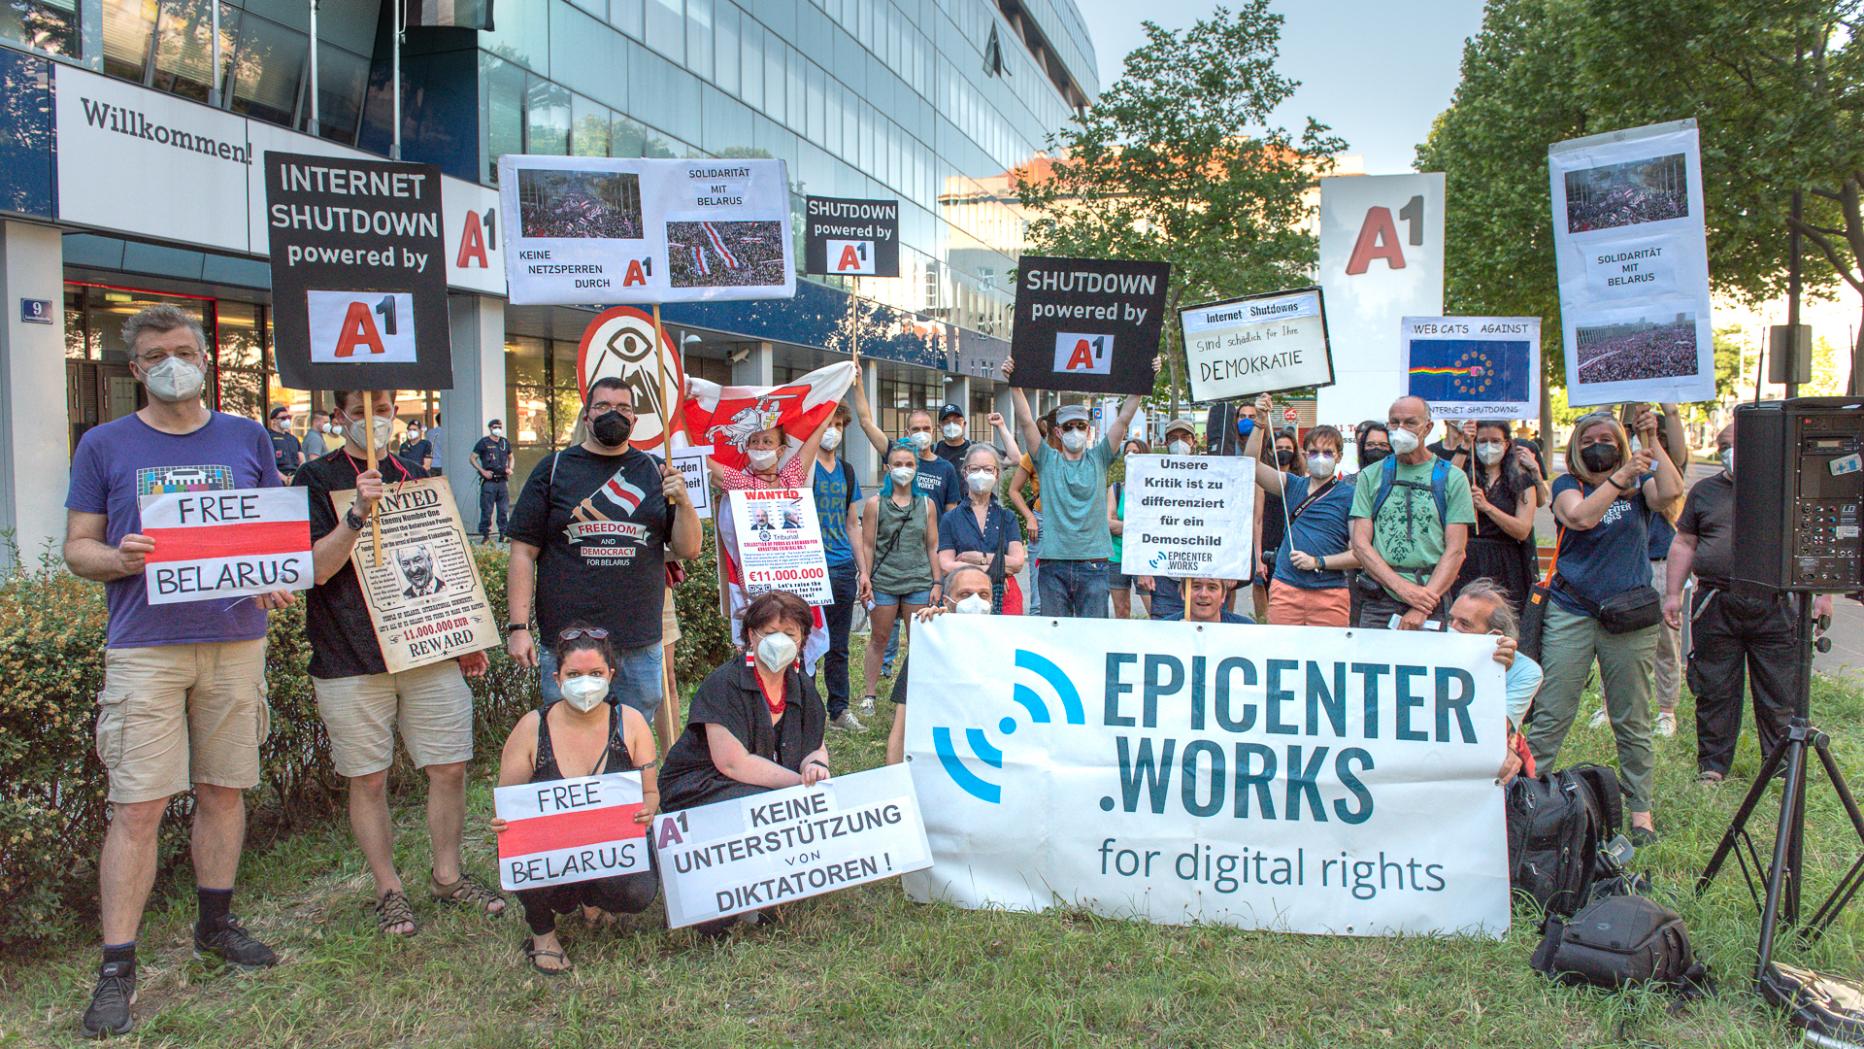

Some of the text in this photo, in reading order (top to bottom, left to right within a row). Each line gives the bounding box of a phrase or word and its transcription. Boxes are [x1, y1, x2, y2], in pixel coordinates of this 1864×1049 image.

[80, 97, 252, 165] Willkommen!
[280, 163, 425, 199] INTERNET
[688, 167, 750, 179] SOLIDARITÄT
[711, 185, 726, 194] MIT
[697, 197, 743, 206] BELARUS
[808, 200, 896, 219] SHUTDOWN
[271, 203, 439, 238] SHUTDOWN
[456, 207, 496, 268] A1
[814, 224, 892, 240] powered by
[1345, 194, 1424, 275] A1
[288, 245, 428, 273] powered by
[519, 250, 551, 260] KEINE
[837, 242, 866, 271] A1
[1597, 247, 1662, 265] SOLIDARITÄT
[528, 264, 603, 275] NETZSPERREN
[575, 256, 652, 288] DURCH A1
[1622, 263, 1639, 273] MIT
[1026, 269, 1157, 295] SHUTDOWN
[1607, 273, 1655, 287] BELARUS
[32, 301, 42, 315] 9
[1032, 302, 1147, 326] powered by
[1206, 302, 1299, 324] Internet Shutdowns
[334, 295, 397, 357] A1
[1414, 324, 1529, 334] WEB CATS AGAINST
[1196, 335, 1221, 353] Sind
[1281, 325, 1299, 336] Ihre
[1066, 336, 1105, 370] A1
[1200, 350, 1303, 383] DEMOKRATIE
[1429, 405, 1519, 414] NTERNET SHUTDOWNS
[1160, 459, 1208, 470] Unsere
[1144, 477, 1223, 489] Kritik ist zu
[744, 490, 799, 500] WANTED
[1141, 496, 1224, 508] differenziert
[178, 494, 260, 524] FREE
[381, 515, 402, 526] Enemy
[402, 511, 427, 522] Number
[427, 508, 441, 518] One
[577, 523, 637, 535] FREEDOM
[1160, 515, 1204, 527] für ein
[773, 533, 799, 541] Tribunal
[1142, 533, 1222, 546] Demoschild
[582, 547, 635, 556] DEMOCRACY
[1168, 551, 1213, 563] EPICENTER
[586, 558, 630, 566] FOR BELARUS
[1167, 561, 1198, 571] .WORKS
[156, 558, 300, 595] BELARUS
[749, 567, 824, 582] €11.000.000
[403, 616, 469, 641] 11.000.000 EUR
[408, 629, 474, 657] REWARD
[1102, 650, 1479, 745] EPICENTER
[1099, 735, 1375, 826] .WORKS
[537, 781, 602, 813] FREE
[750, 793, 829, 828] KEINE
[657, 810, 689, 849] A1
[673, 804, 902, 874] UNTERSTÜTZUNG
[511, 843, 636, 885] BELARUS
[784, 850, 821, 867] VON
[1098, 837, 1447, 900] for digital rights
[716, 852, 893, 913] DIKTATOREN !
